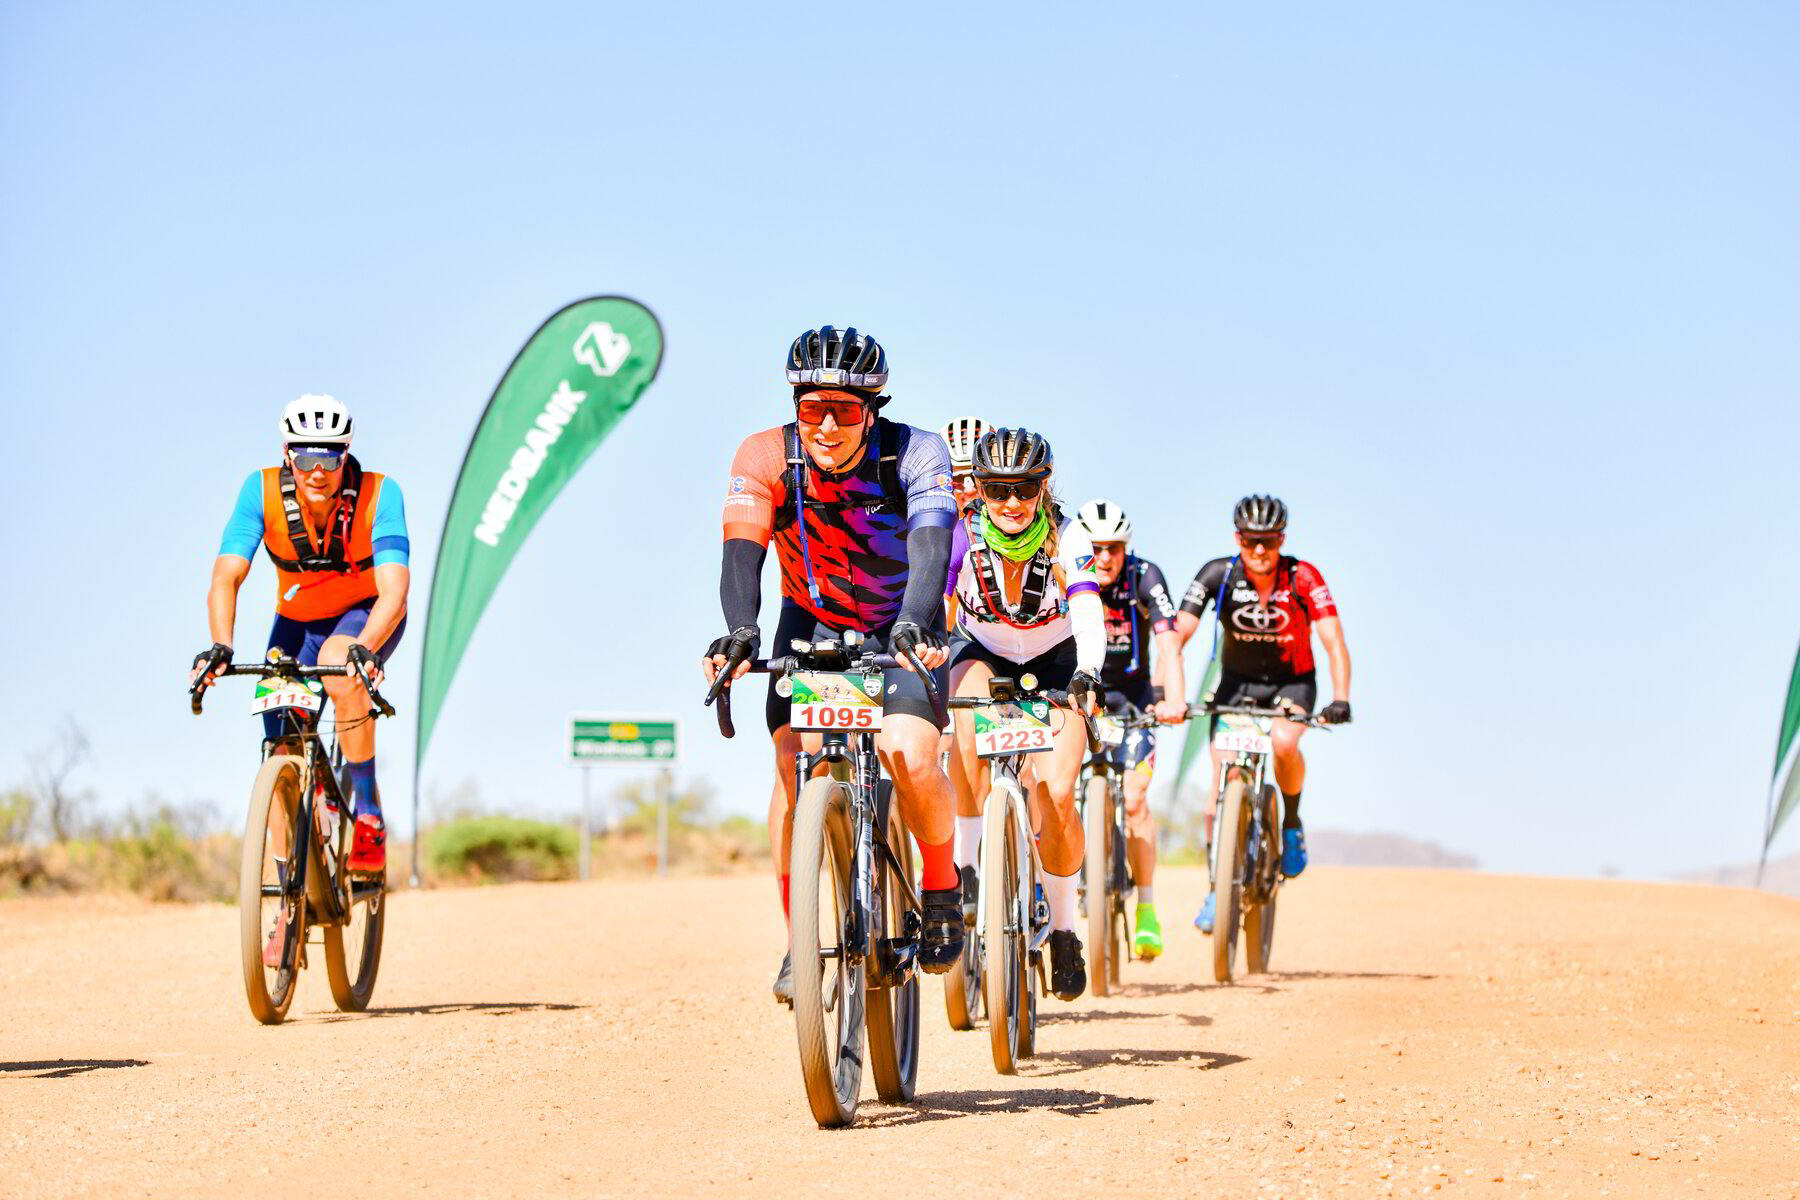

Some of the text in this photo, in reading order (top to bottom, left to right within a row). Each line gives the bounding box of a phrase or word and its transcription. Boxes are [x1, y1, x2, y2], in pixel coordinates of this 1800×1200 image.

[473, 378, 588, 547] NEDBANK
[1231, 631, 1296, 643] TOYOTA
[261, 692, 313, 710] 1115
[801, 705, 873, 727] 1095
[985, 728, 1047, 752] 1223
[1223, 735, 1265, 752] 1126
